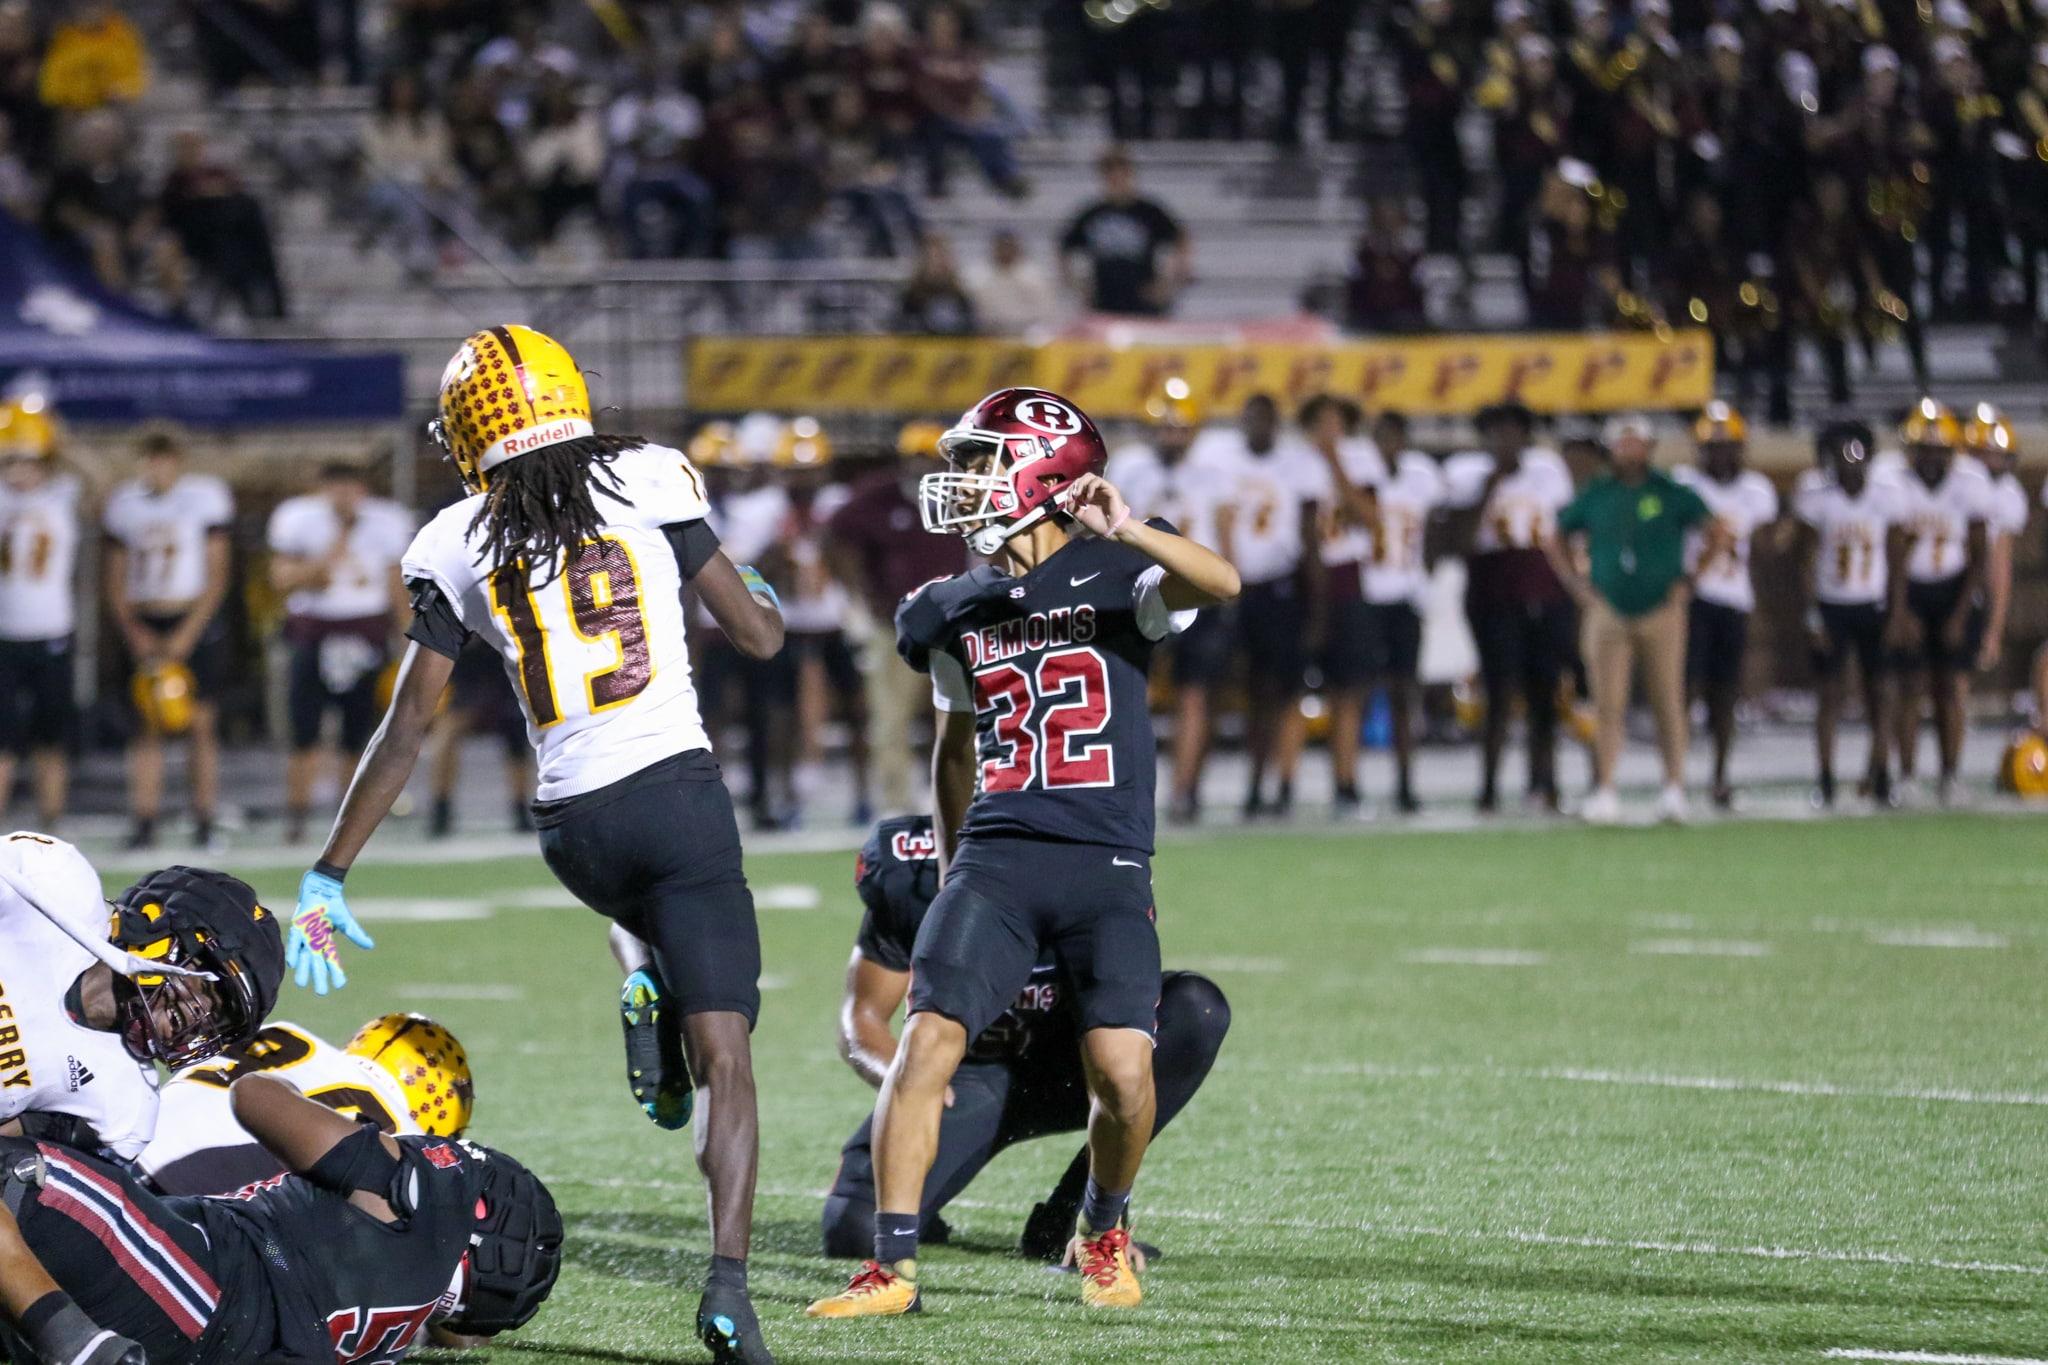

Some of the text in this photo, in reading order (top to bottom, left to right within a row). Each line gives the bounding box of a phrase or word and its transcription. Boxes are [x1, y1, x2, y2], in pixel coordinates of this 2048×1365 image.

[503, 421, 576, 456] Riddell
[1025, 401, 1074, 431] R
[488, 533, 658, 730] 19
[960, 604, 1096, 669] DEMONS
[972, 646, 1115, 794] 32
[0, 982, 33, 1089] ERRY
[67, 1054, 80, 1092] adidas
